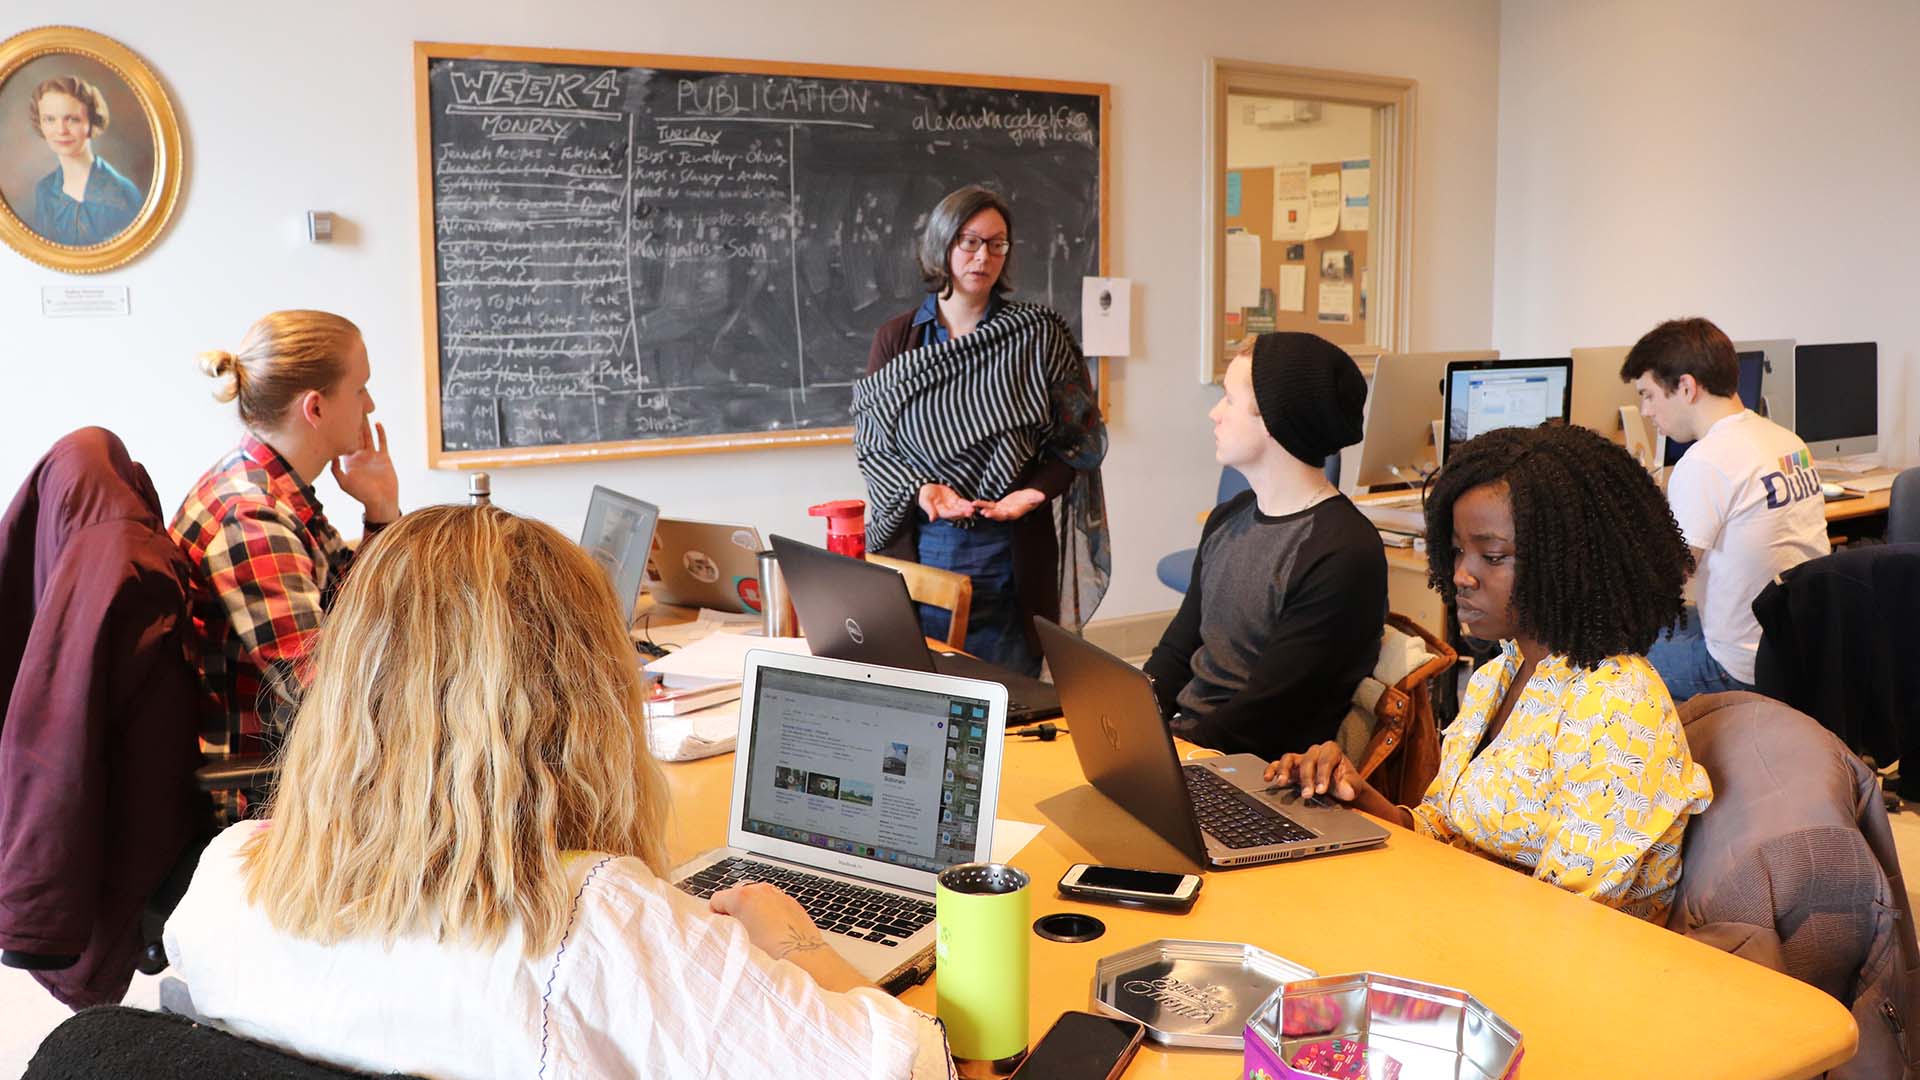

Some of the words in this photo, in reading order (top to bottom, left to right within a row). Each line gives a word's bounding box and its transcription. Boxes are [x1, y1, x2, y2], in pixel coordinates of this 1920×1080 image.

[450, 71, 585, 108] WEEK
[583, 69, 620, 108] 4
[482, 115, 571, 144] MONDAY
[657, 125, 722, 145] Tuesday
[727, 238, 767, 259] Sam
[1760, 465, 1823, 510] Dulu
